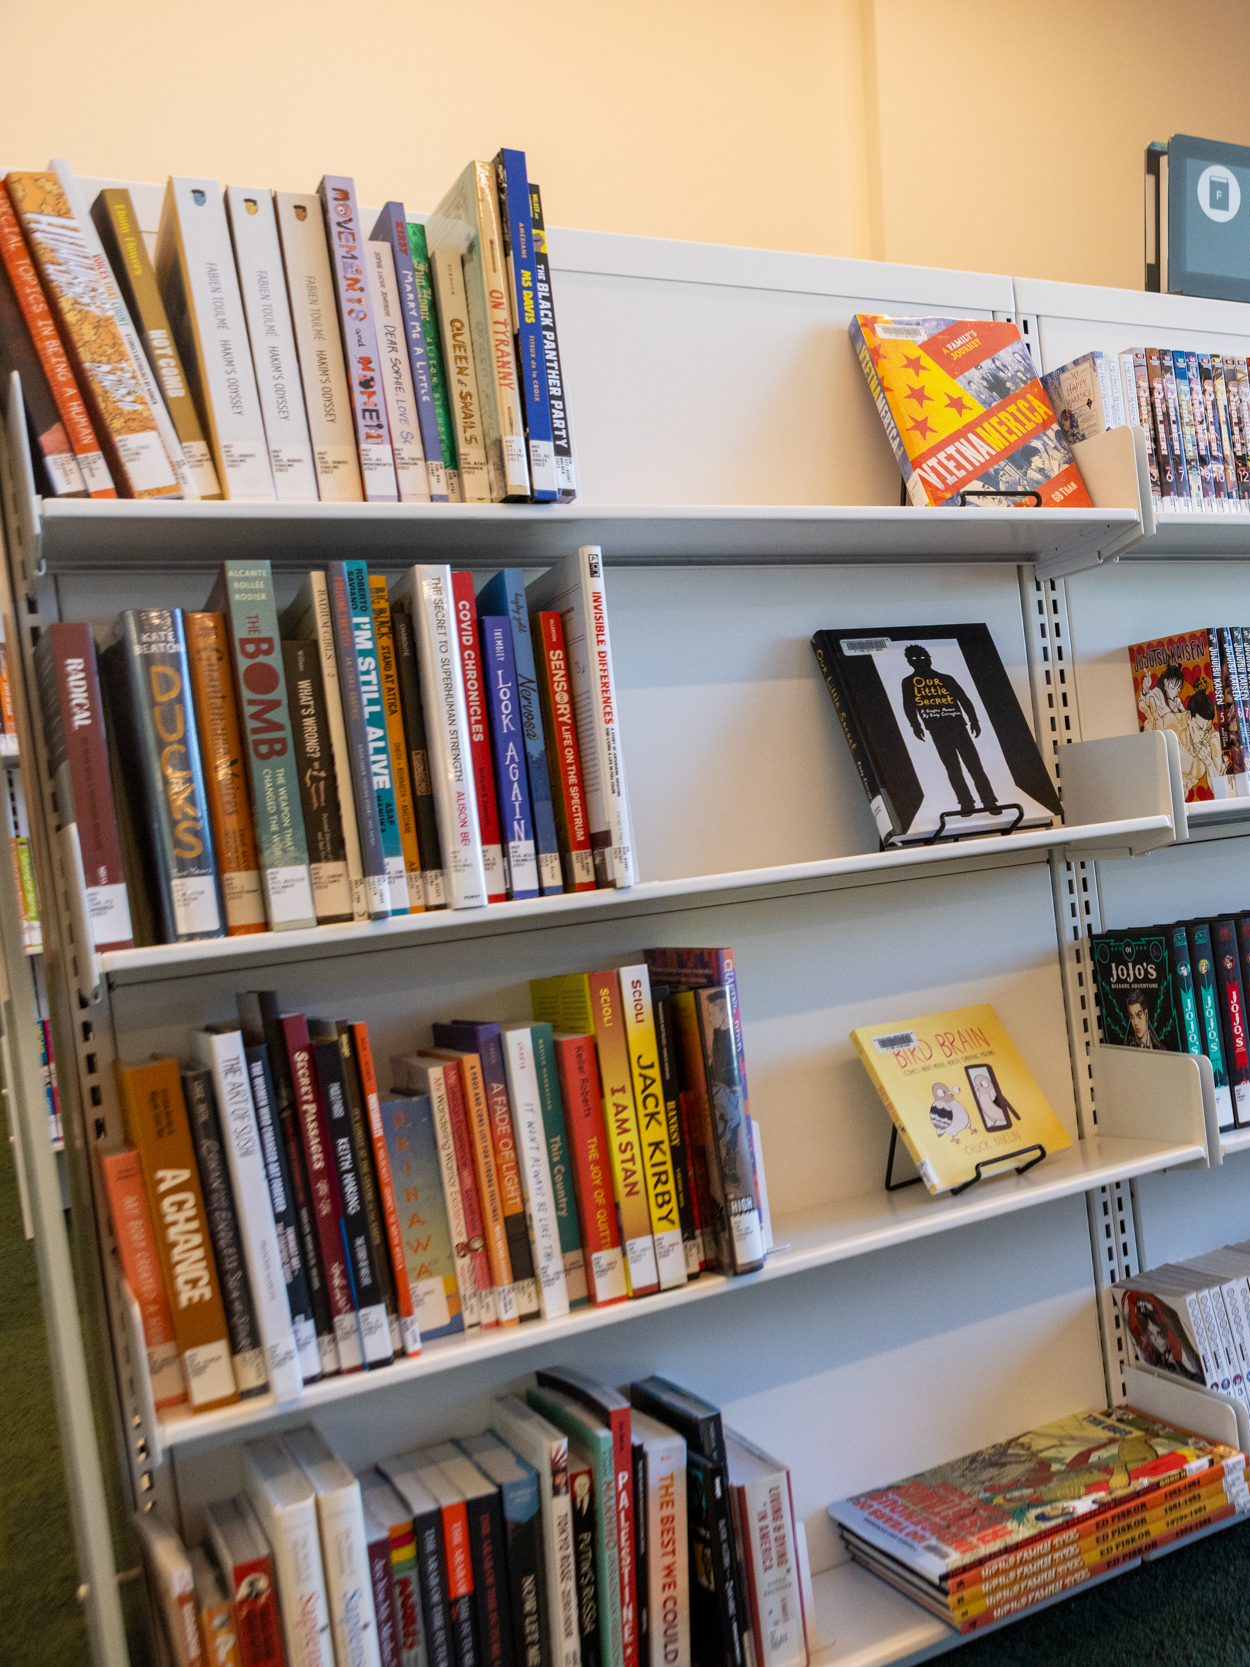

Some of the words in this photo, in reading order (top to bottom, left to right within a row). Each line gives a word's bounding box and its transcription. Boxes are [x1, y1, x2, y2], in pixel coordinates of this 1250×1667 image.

[395, 221, 409, 256] KIRBY
[15, 258, 48, 314] TOPICS
[206, 262, 221, 293] FABIEN
[520, 269, 533, 288] MS
[536, 263, 547, 281] THE
[402, 270, 419, 317] MARRY
[489, 289, 505, 310] ON
[522, 289, 536, 324] DAVIS
[537, 279, 554, 327] BLACK
[36, 320, 56, 338] IN
[213, 296, 229, 331] TOULMÉ
[410, 321, 423, 338] ME
[44, 328, 72, 382] BEING
[148, 329, 173, 355] HOT
[355, 329, 366, 347] and
[383, 324, 399, 353] DEAR
[413, 346, 424, 356] A
[449, 318, 470, 377] QUEEN
[492, 319, 516, 391] TYRANNY
[941, 347, 949, 355] A
[946, 329, 978, 352] FAMILY'S
[950, 338, 982, 361] JOURNEY
[220, 340, 237, 376] HAKIM'S
[267, 346, 284, 382] HAKIM'S
[389, 357, 406, 395] SOPHIE,
[542, 331, 560, 396] PANTHER
[64, 387, 78, 398] A
[158, 357, 185, 398] COMB
[416, 361, 430, 402] LITTLE
[1065, 377, 1088, 395] HAPPY
[226, 378, 244, 417] ODYSSEY
[273, 383, 290, 421] ODYSSEY
[396, 399, 409, 426] LOVE
[858, 344, 901, 449] VIETNAMERICA
[69, 401, 95, 445] HUMAN
[459, 390, 479, 446] SNAILS
[550, 400, 568, 449] PARTY
[915, 393, 1054, 491] VIETNAMERICA
[1051, 490, 1063, 503] GB
[1058, 481, 1079, 498] TRAN
[228, 569, 269, 578] ALCANTE
[233, 580, 266, 589] BOLLÉE
[347, 570, 359, 610] SAVIANO
[355, 568, 368, 613] ROBERTO
[431, 577, 441, 596] THE
[234, 593, 268, 601] RODIER
[370, 587, 387, 605] BIG
[246, 613, 262, 636] THE
[352, 616, 374, 650] I'M
[373, 607, 392, 640] BLACK
[434, 599, 447, 636] SECRET
[458, 600, 474, 646] COVID
[591, 591, 607, 647] INVISIBLE
[140, 631, 176, 644] KATE
[439, 640, 449, 655] TO
[494, 628, 505, 661] TREMBLEY
[381, 645, 393, 672] STAND
[1134, 648, 1172, 673] JUJUTSU
[1170, 640, 1206, 664] KAISEN
[1209, 647, 1221, 676] JUJUTSU
[64, 658, 92, 732] RADICAL
[238, 636, 290, 761] BOMB
[357, 657, 381, 719] STILL
[385, 674, 394, 686] AT
[440, 657, 457, 727] SUPERHUMAN
[463, 650, 484, 743] CHRONICLES
[549, 650, 572, 724] SENSORY
[597, 651, 615, 725] DIFFERENCES
[913, 676, 944, 688] Our
[914, 686, 950, 697] Little
[1214, 679, 1224, 705] KAISEN
[297, 679, 315, 720] WHAT'S
[385, 686, 399, 717] ATTICA
[496, 669, 516, 734] LOOK
[517, 673, 539, 742] Nervosa
[915, 695, 954, 706] Secret
[1220, 712, 1225, 722] 5
[301, 720, 321, 758] WRONG?
[561, 726, 573, 746] LIFE
[150, 665, 203, 859] DUCKS
[365, 725, 391, 790] ALIVE
[449, 727, 464, 783] STRENGTH
[564, 748, 576, 765] ON
[504, 741, 526, 842] AGAIN
[566, 766, 577, 783] THE
[376, 795, 387, 834] HANUKA
[456, 791, 469, 829] ALISON
[569, 784, 586, 842] SPECTRUM
[1110, 962, 1157, 982] JoJo's
[599, 987, 613, 1028] SCIOLI
[631, 978, 645, 1024] SCIOLI
[1206, 995, 1218, 1052] JOJO'S
[893, 1039, 933, 1069] BIRD
[934, 1027, 991, 1059] BRAIN
[294, 1051, 314, 1104] SECRET
[491, 1082, 503, 1095] A
[610, 1084, 627, 1098] I
[637, 1053, 663, 1132] JACK
[493, 1095, 510, 1136] FADE
[613, 1102, 630, 1138] AM
[302, 1102, 326, 1171] PASSAGES
[500, 1137, 515, 1159] OF
[155, 1168, 192, 1193] A
[502, 1160, 522, 1207] LIGHT
[618, 1140, 640, 1198] STAN
[647, 1138, 676, 1227] KIRBY
[161, 1191, 213, 1309] CHANCE
[658, 1472, 675, 1509] THE
[1095, 1517, 1110, 1530] ED
[1111, 1502, 1147, 1525] PISKOR
[659, 1512, 677, 1559] BEST
[617, 1471, 635, 1645] PALESTINE
[660, 1559, 678, 1593] WE
[662, 1596, 679, 1667] COULD
